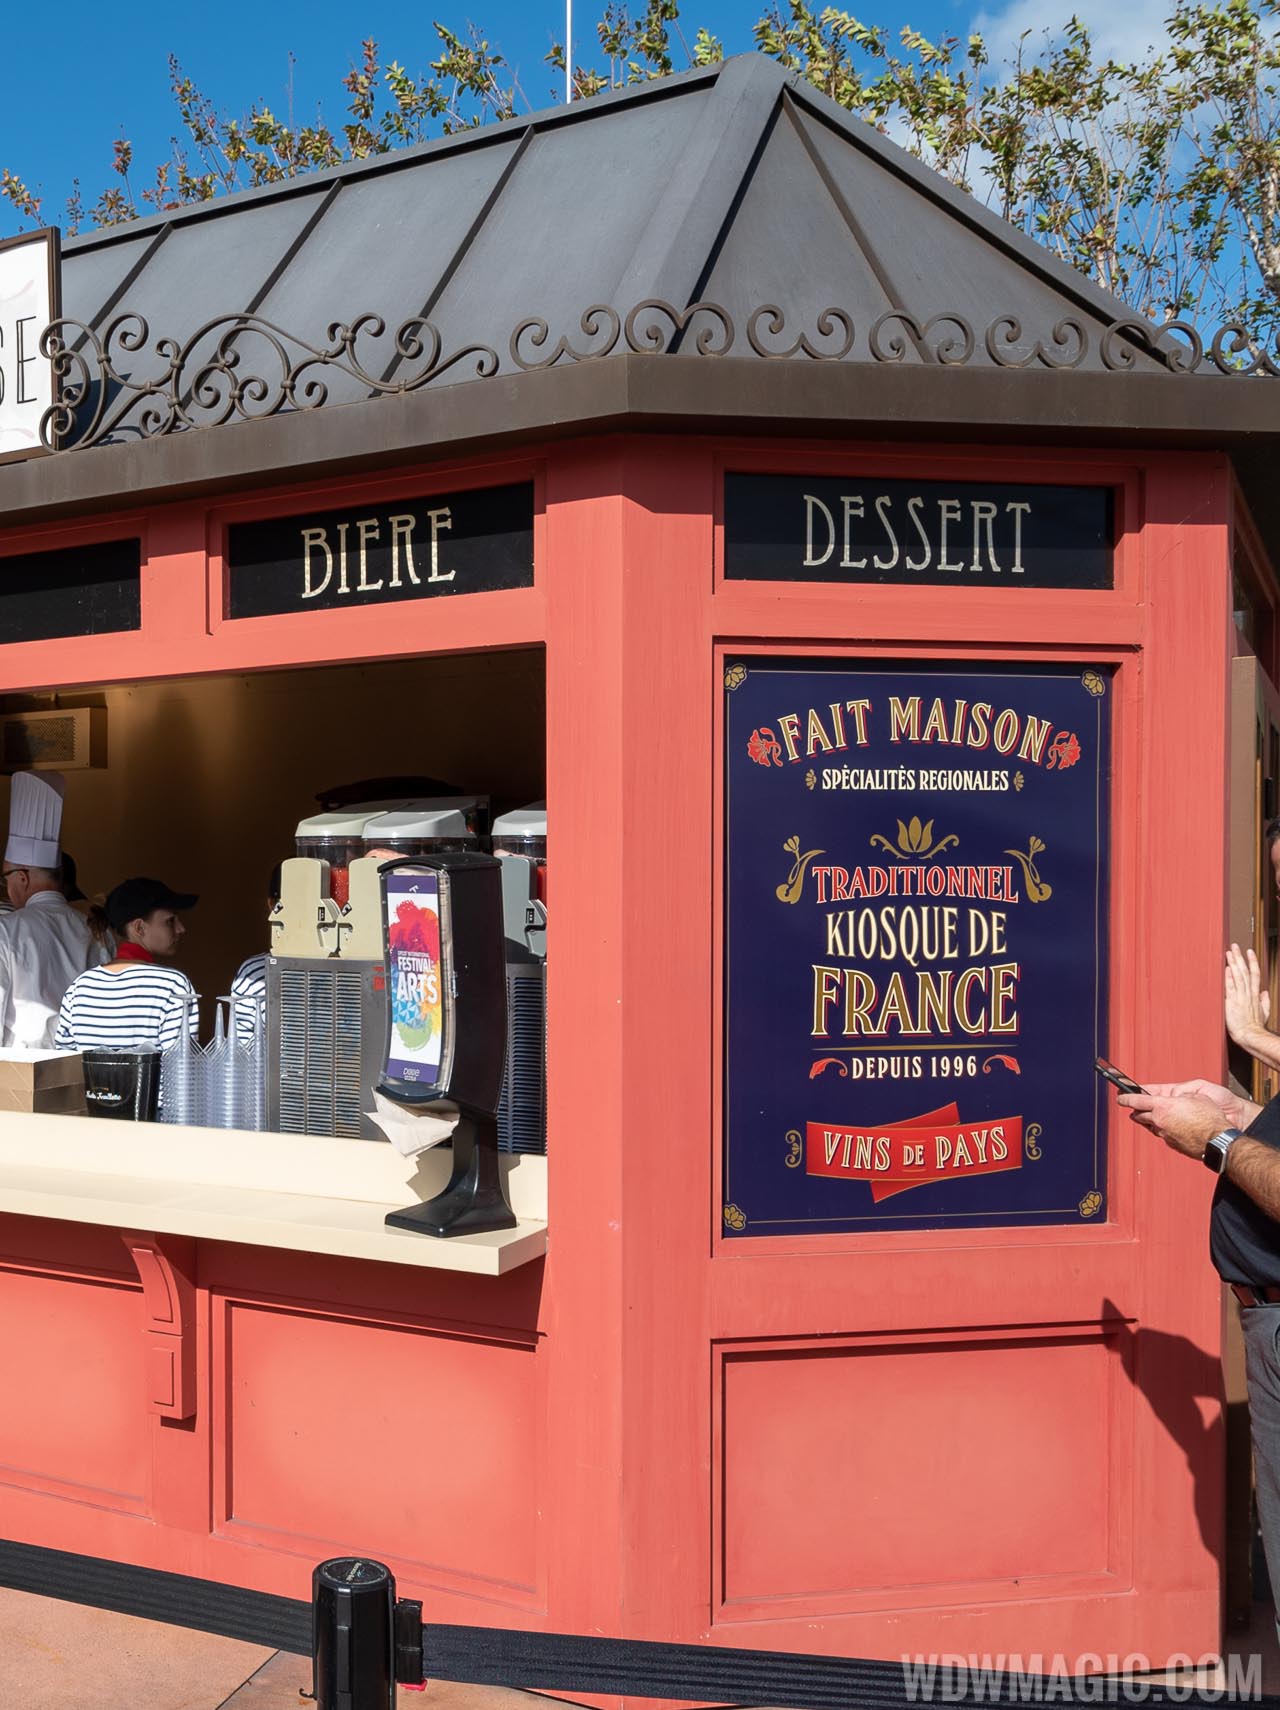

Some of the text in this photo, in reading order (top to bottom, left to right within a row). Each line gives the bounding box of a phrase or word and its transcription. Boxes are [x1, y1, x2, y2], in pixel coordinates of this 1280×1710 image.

[300, 507, 457, 599] BIERE
[802, 495, 1032, 575] DESSERT
[777, 697, 1055, 765] FAIT MAISON
[919, 769, 1009, 791] REGIONALES
[812, 866, 1019, 904] TRADITIONNEL
[826, 905, 1008, 966] KIOSQUE DE
[397, 971, 438, 1004] ARTS
[398, 957, 431, 973] FESTIVAL
[810, 963, 1020, 1038] FRANCE
[851, 1055, 977, 1079] DEPUIS 1996
[823, 1126, 1009, 1172] VINS DE PAYS
